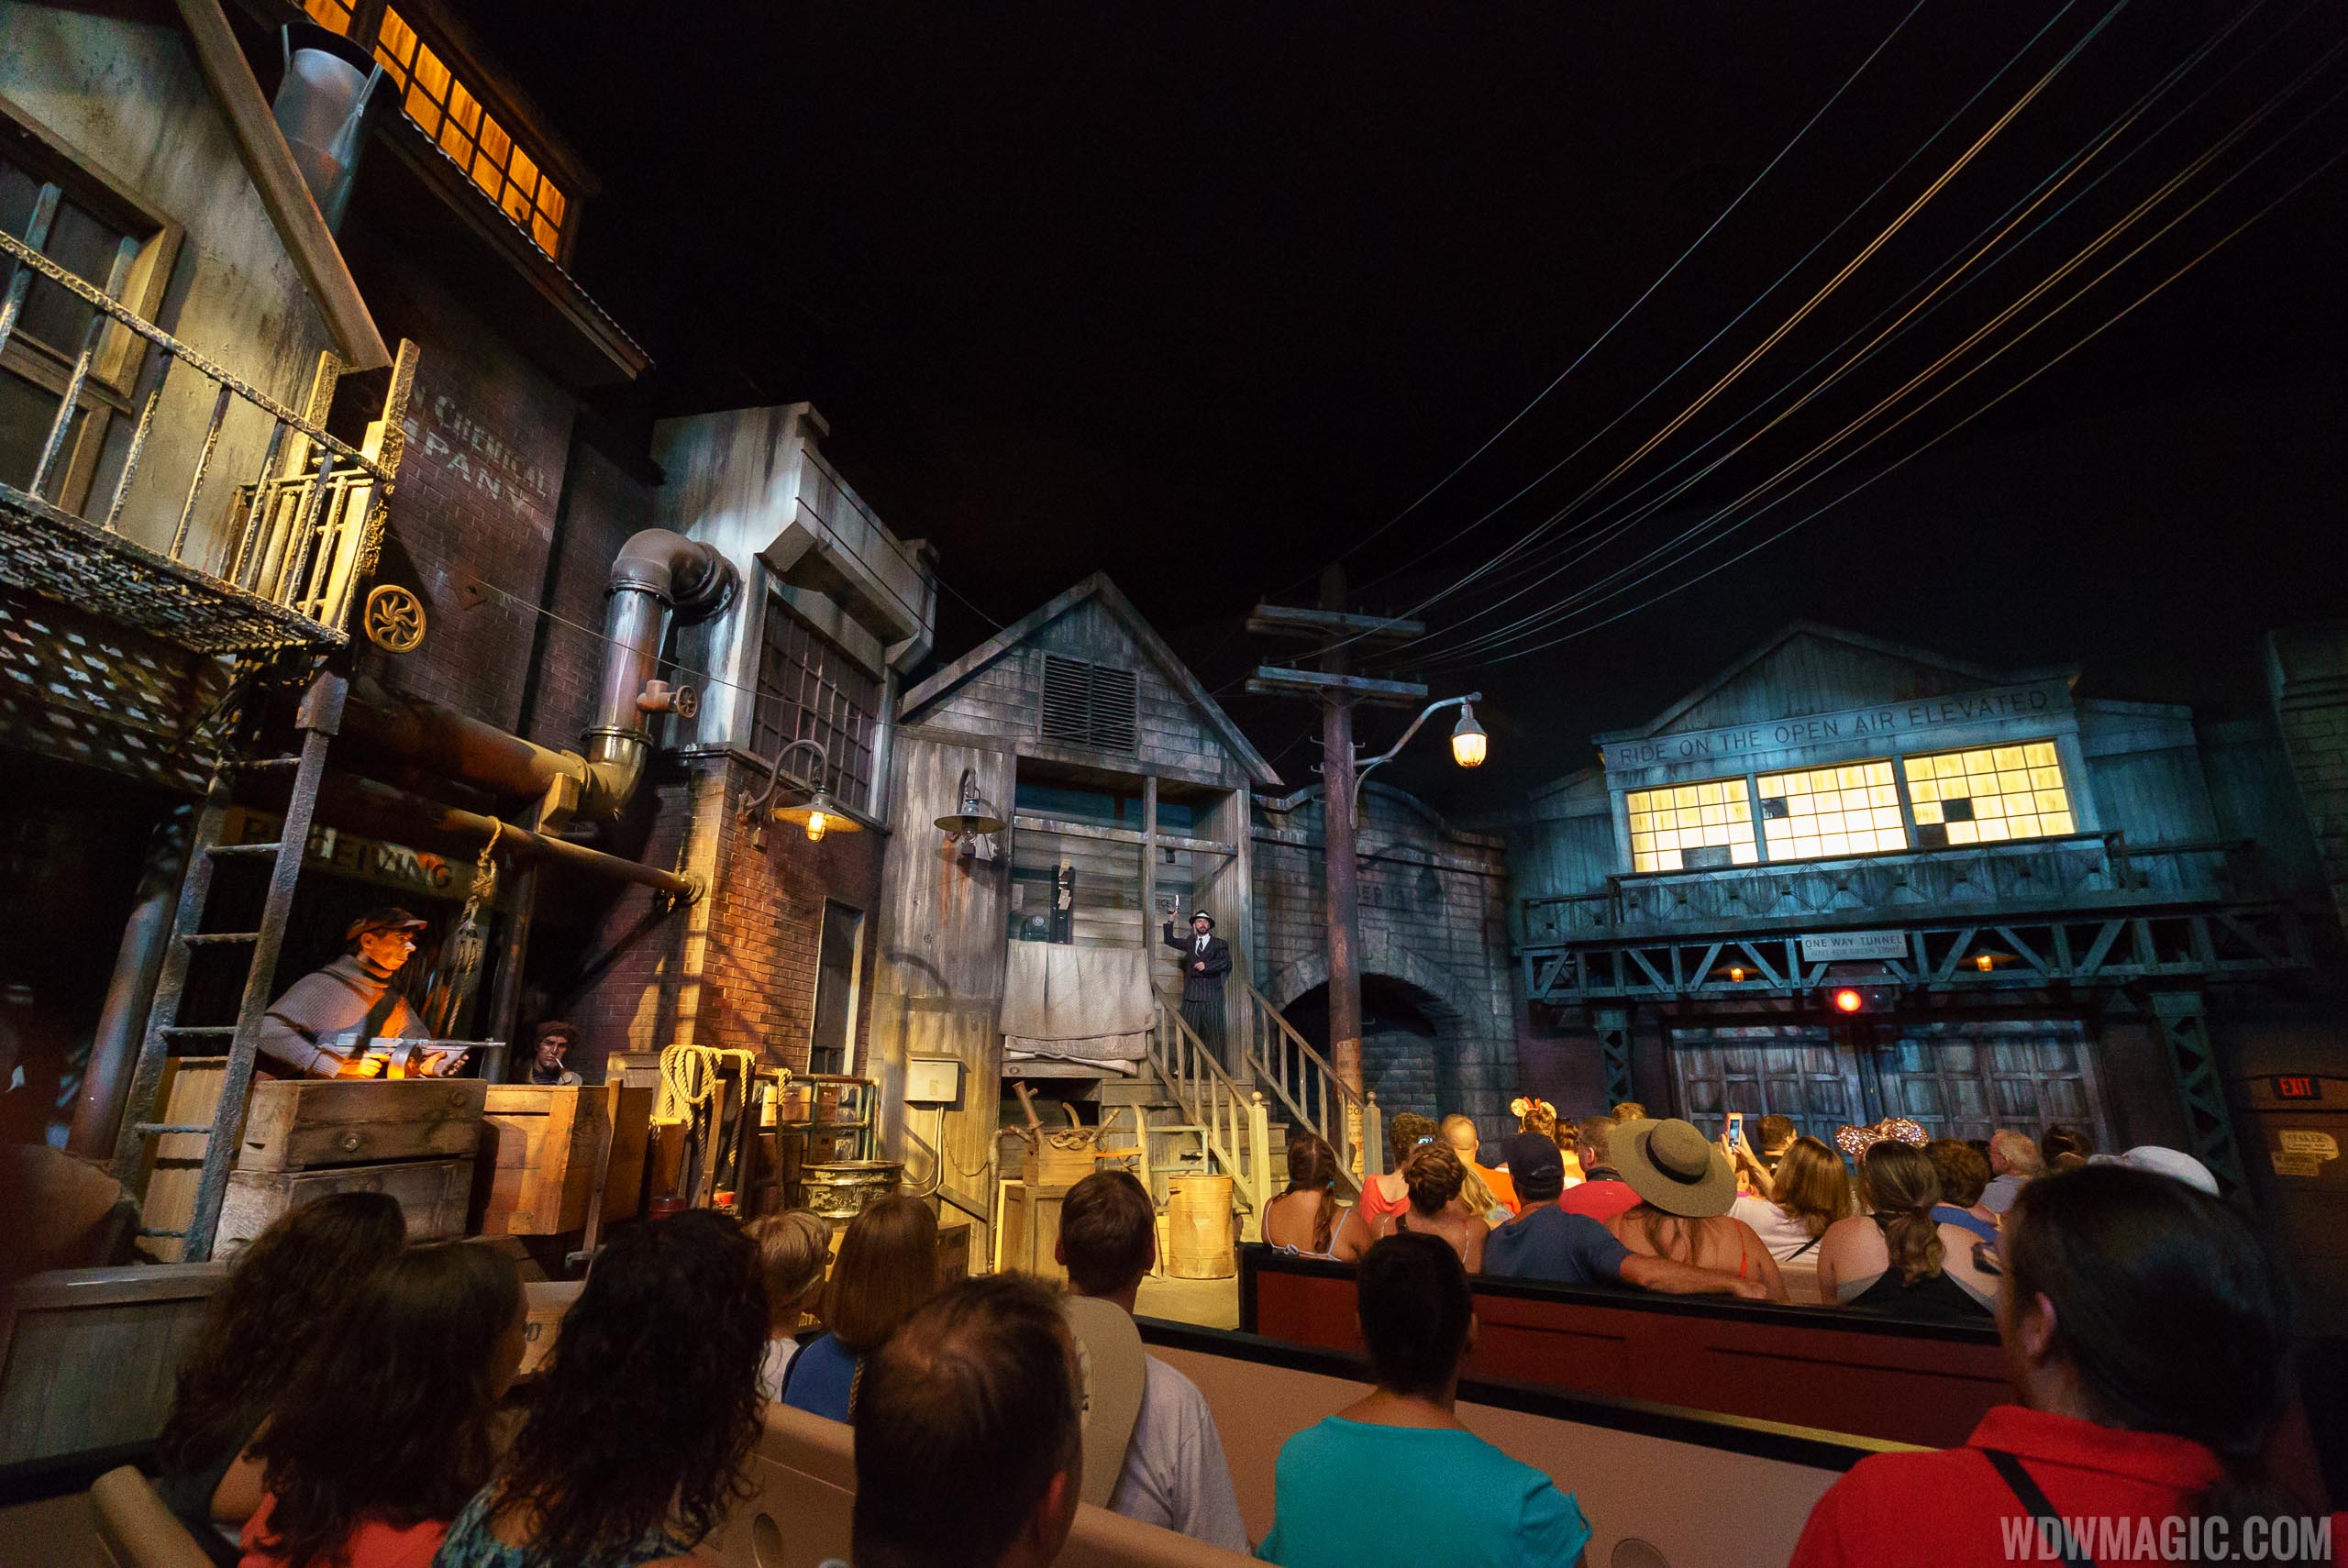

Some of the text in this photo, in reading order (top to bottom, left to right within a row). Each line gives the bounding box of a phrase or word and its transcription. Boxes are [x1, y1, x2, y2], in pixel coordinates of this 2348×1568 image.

[1620, 691, 2048, 764] RIDE ON THE OPEN AIR ELEVATED
[1805, 935, 1902, 948] ONE WAY TUNNEL
[2279, 1077, 2311, 1096] EXIT
